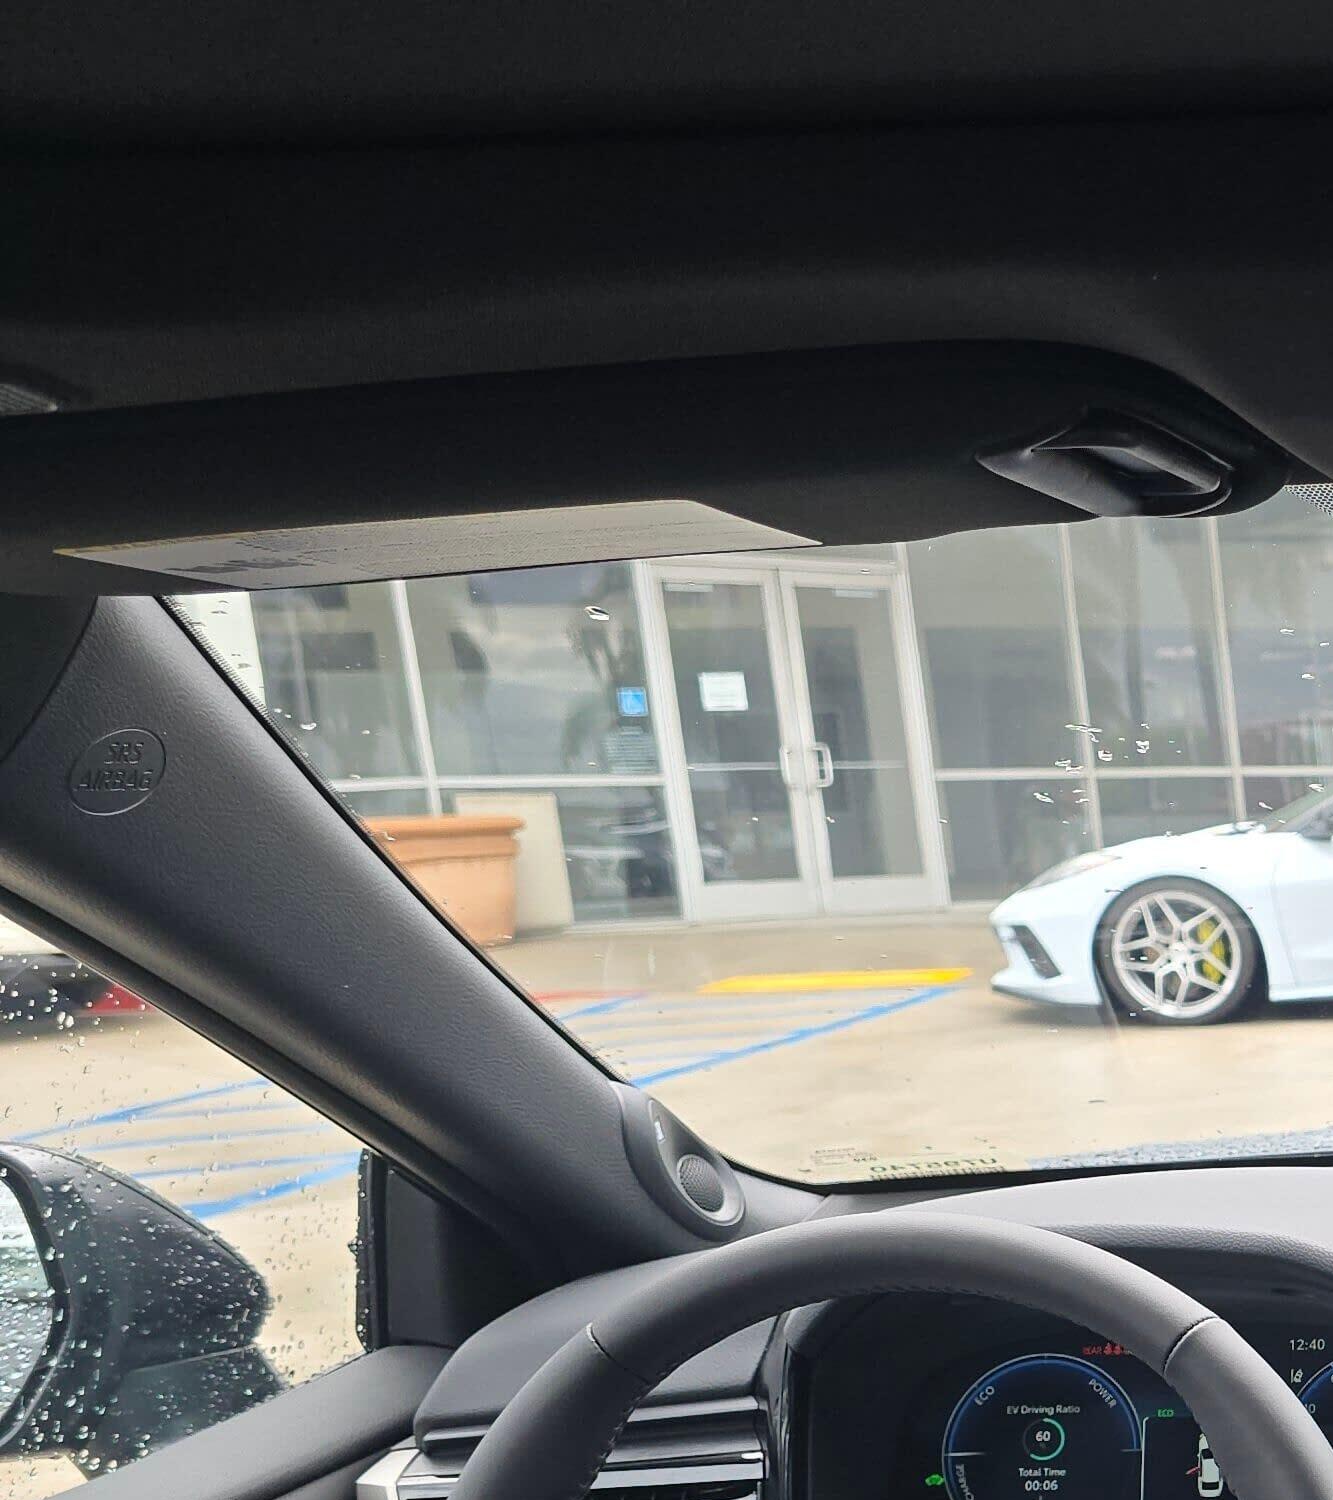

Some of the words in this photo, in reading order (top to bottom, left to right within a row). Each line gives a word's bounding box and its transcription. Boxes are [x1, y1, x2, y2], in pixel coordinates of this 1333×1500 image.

[104, 742, 144, 764] SRS
[73, 769, 153, 792] AIRBAG
[1289, 1338, 1325, 1351] 12:40
[974, 1386, 995, 1406] ECO
[1088, 1378, 1117, 1408] POWER
[1006, 1405, 1020, 1415] EV
[1021, 1405, 1054, 1416] Driving
[1056, 1404, 1081, 1414] Ratio
[1157, 1409, 1174, 1418] ECO
[1035, 1431, 1051, 1442] 60
[1018, 1468, 1042, 1477] Total
[1044, 1468, 1066, 1477] Time
[1024, 1480, 1059, 1492] 00:06
